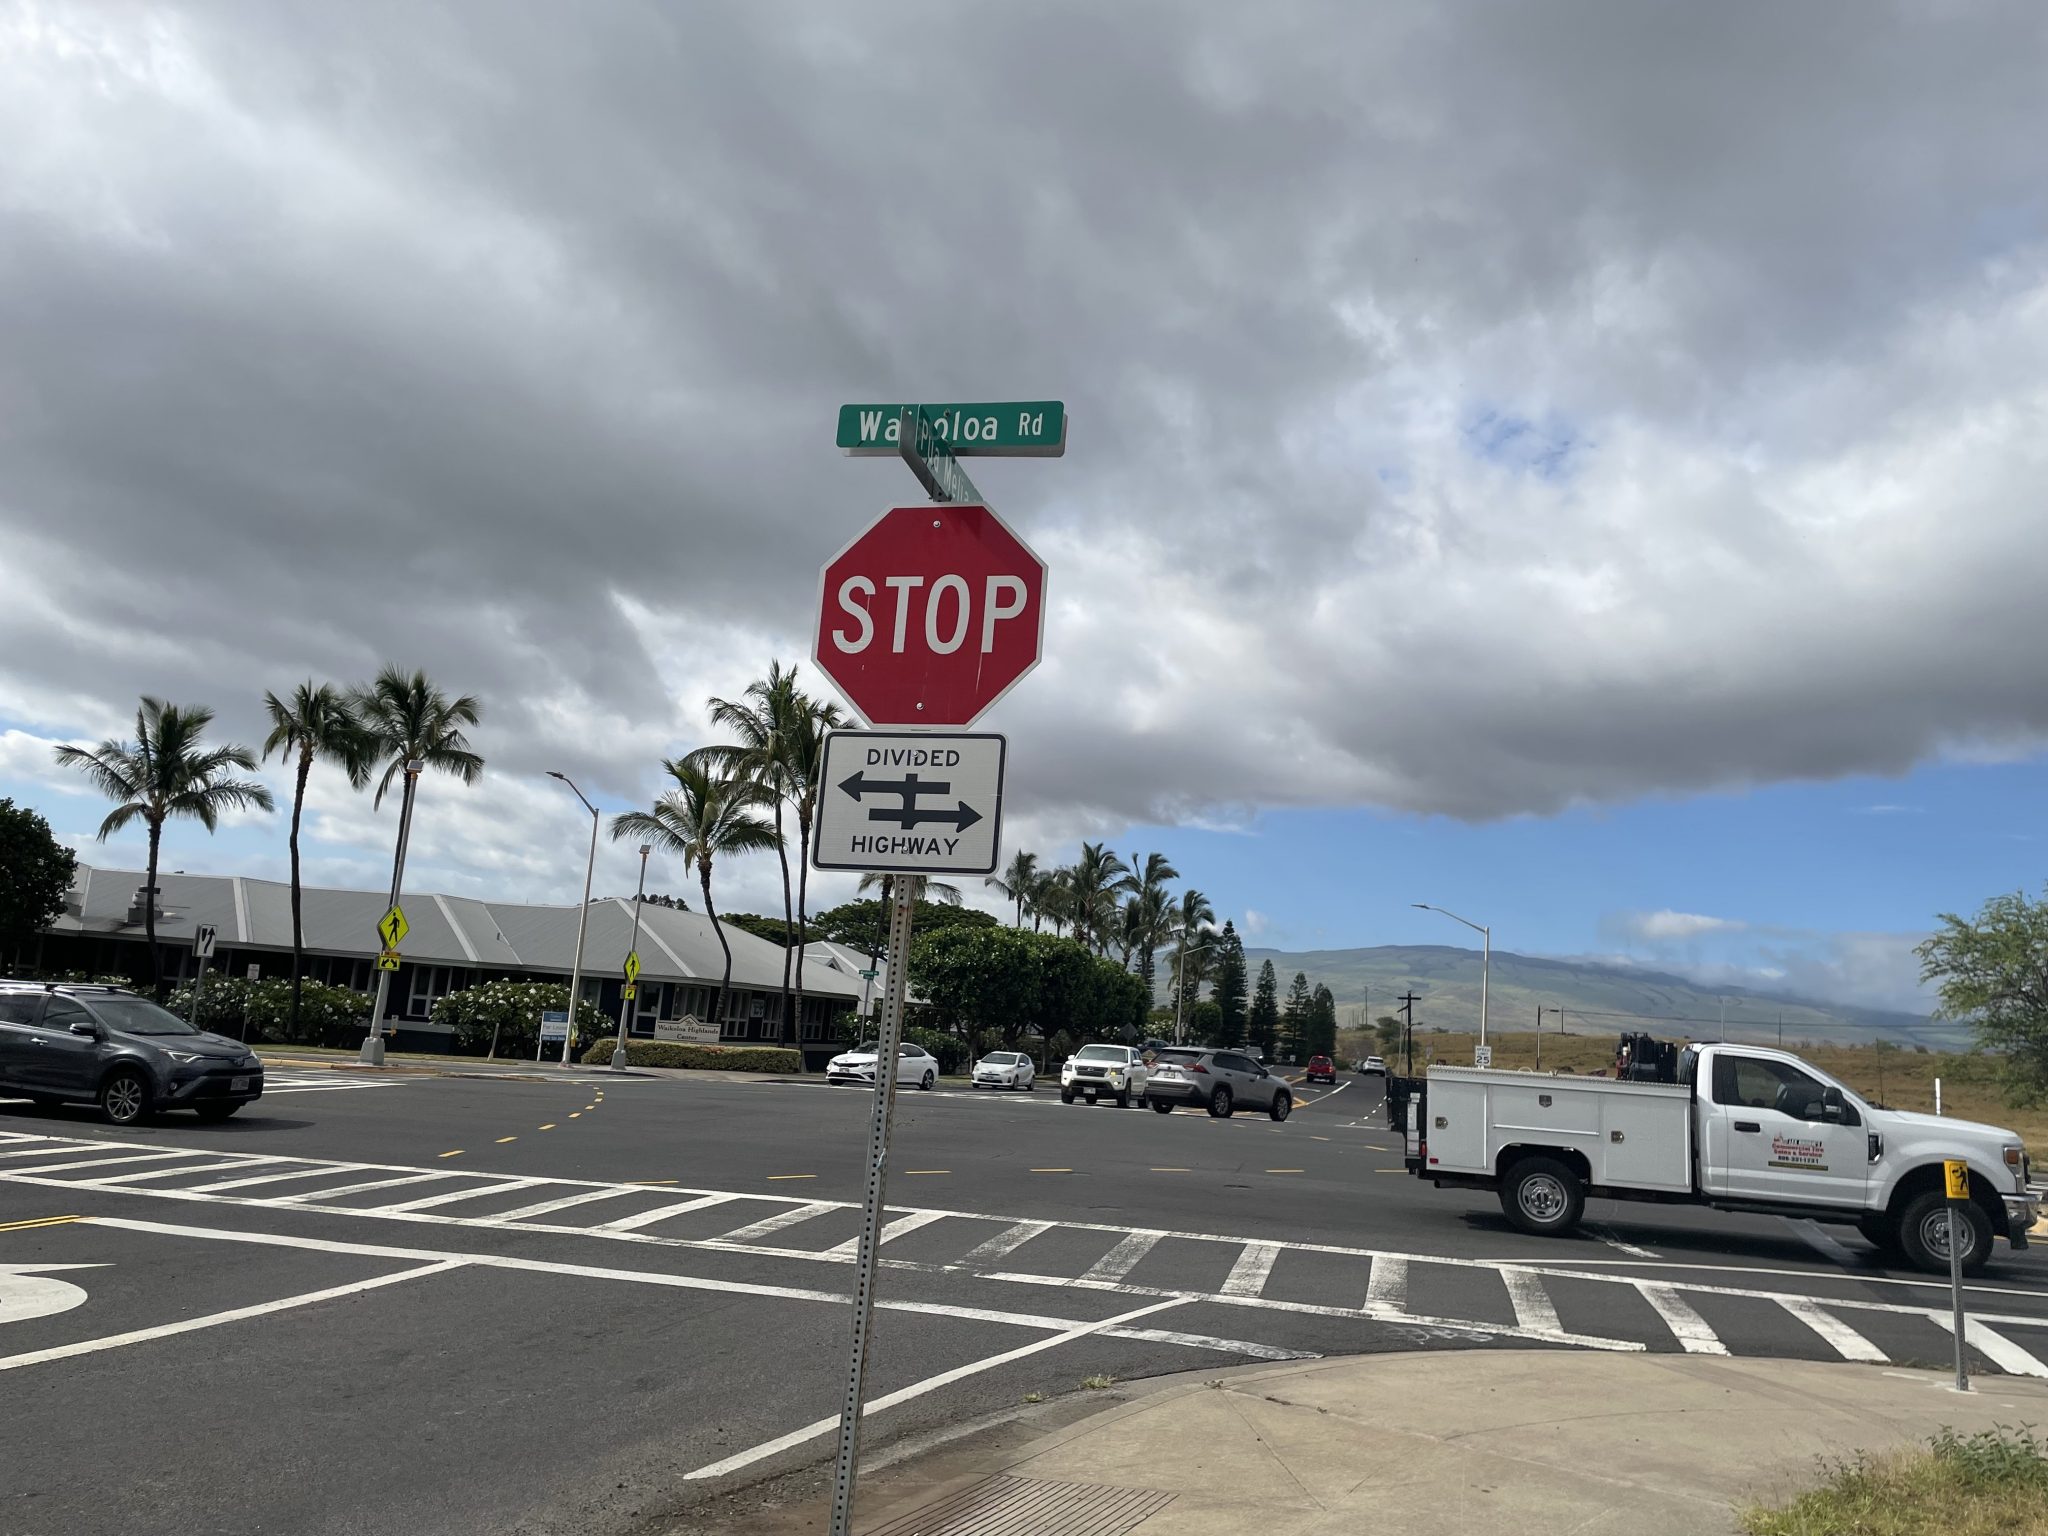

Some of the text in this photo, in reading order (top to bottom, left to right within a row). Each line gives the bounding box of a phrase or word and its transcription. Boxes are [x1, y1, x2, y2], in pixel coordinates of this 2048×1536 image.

[860, 411, 1043, 442] Waoloa Rd
[831, 574, 1029, 656] STOP
[866, 748, 961, 768] DIVIDED
[851, 835, 960, 857] HIGHWAY
[1476, 1056, 1490, 1064] 25
